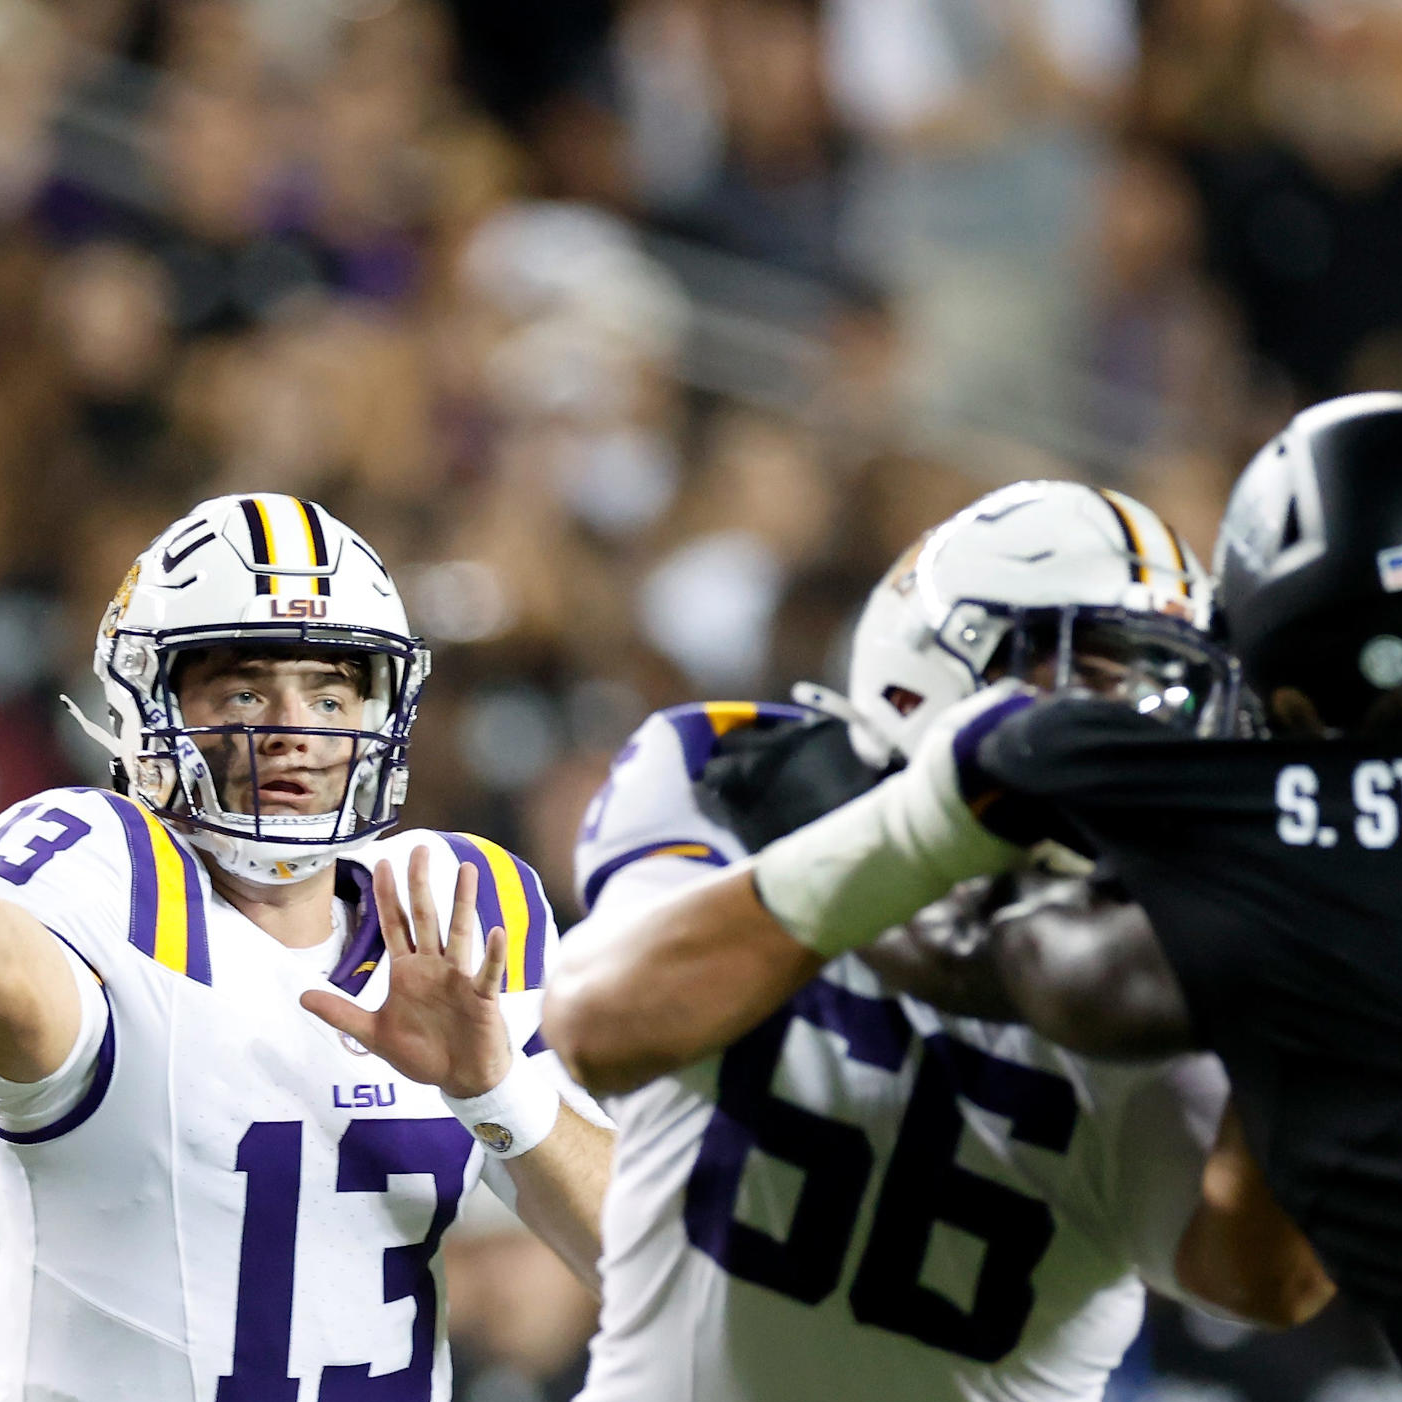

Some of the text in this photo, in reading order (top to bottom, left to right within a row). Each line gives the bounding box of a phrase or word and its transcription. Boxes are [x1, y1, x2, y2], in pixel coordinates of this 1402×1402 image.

[270, 598, 327, 618] LSU
[1274, 763, 1339, 849] S.
[333, 1082, 397, 1108] LSU
[683, 976, 1081, 1364] 66
